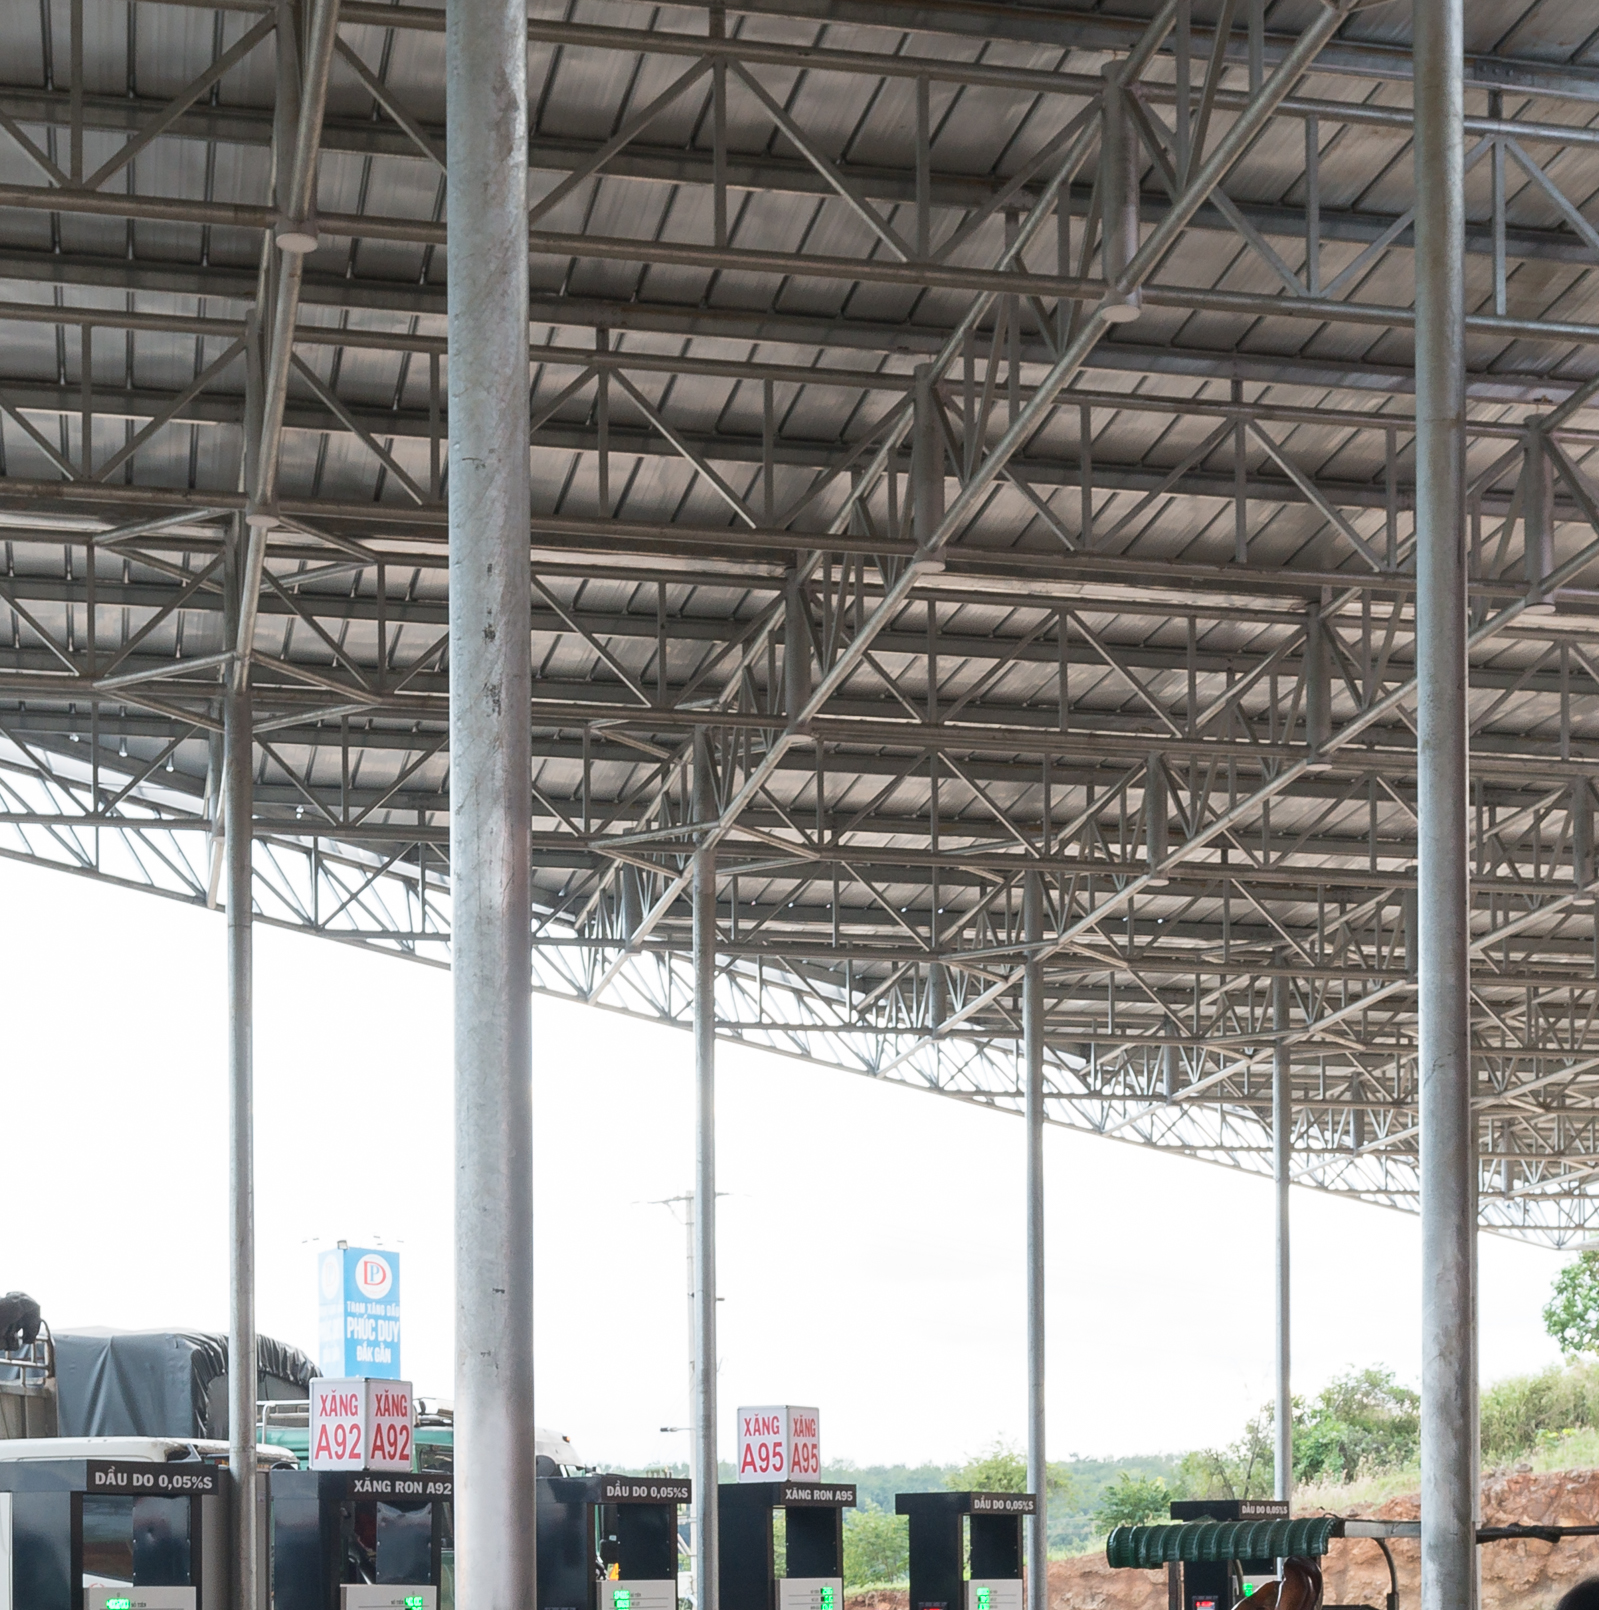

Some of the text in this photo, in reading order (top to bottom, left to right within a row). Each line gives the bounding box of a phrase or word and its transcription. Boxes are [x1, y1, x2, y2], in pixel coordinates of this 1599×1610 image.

[346, 1314, 376, 1340] PHÚC
[377, 1319, 400, 1342] DUY
[319, 1389, 358, 1417] XĂNG
[375, 1389, 408, 1417] XĂNG
[744, 1413, 780, 1437] XĂNG
[793, 1415, 816, 1437] XĂNG
[315, 1423, 361, 1460] A92
[370, 1423, 410, 1461] A92
[740, 1441, 784, 1473] A95
[791, 1442, 818, 1473] A95
[94, 1466, 213, 1490] DẦU DO 0,05%S
[354, 1477, 452, 1495] XĂNG RON A92
[606, 1480, 689, 1499] DẦU DO 0,05%S
[785, 1487, 853, 1501] XĂNG RON A95
[974, 1495, 991, 1509] DẦU
[992, 1499, 1004, 1509] DO
